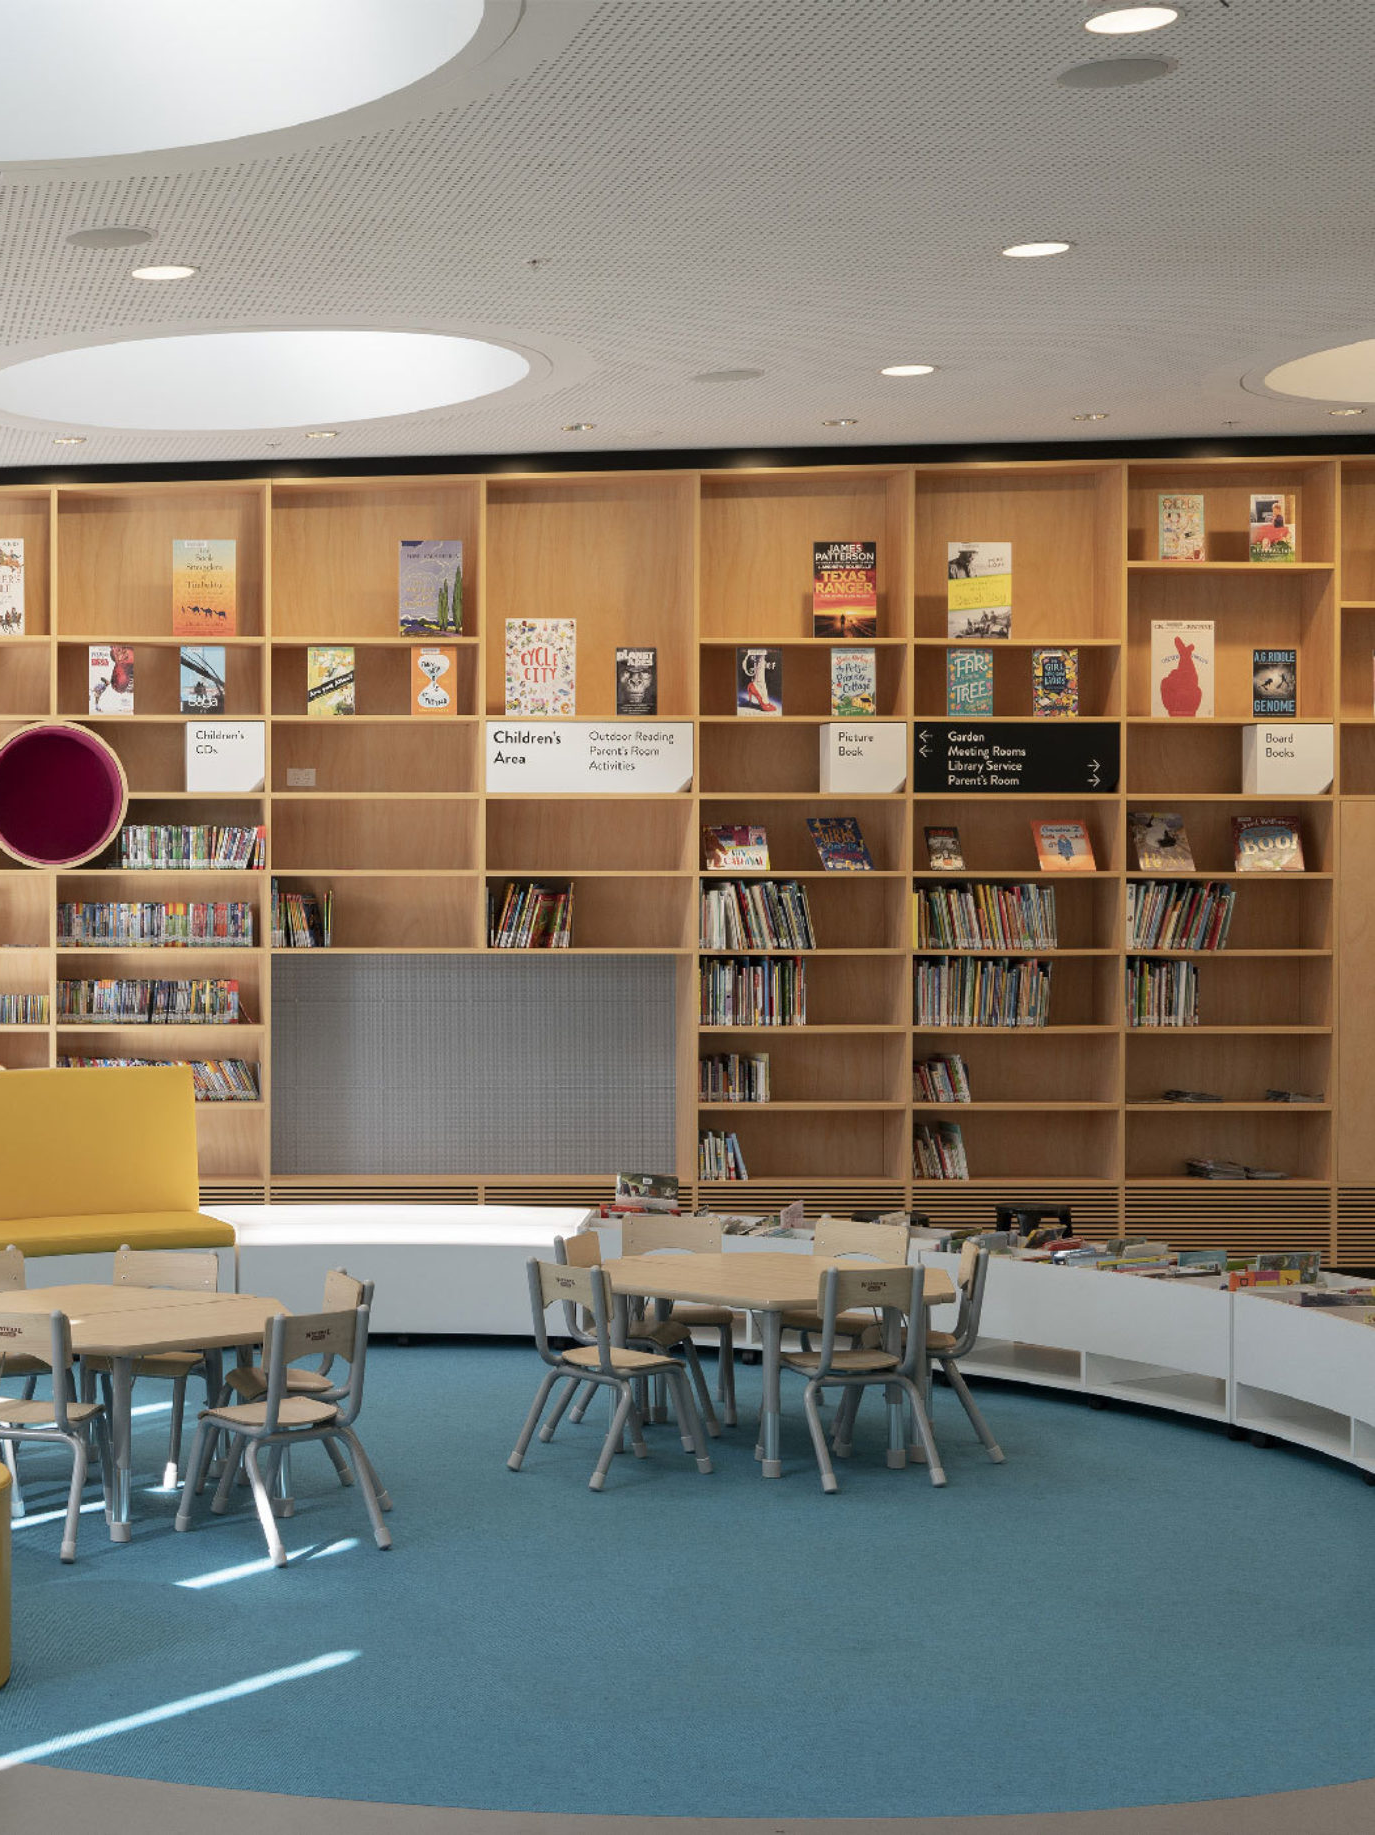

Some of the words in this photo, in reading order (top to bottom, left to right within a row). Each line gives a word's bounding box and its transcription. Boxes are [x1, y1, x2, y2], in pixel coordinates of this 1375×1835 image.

[827, 544, 863, 555] JAMES
[815, 552, 874, 561] PATTERSON
[820, 570, 867, 583] TEXAS
[815, 582, 874, 594] RANGER
[520, 646, 558, 667] CYCLE
[1268, 651, 1296, 662] RIDDLE
[954, 654, 988, 678] FAR
[1045, 663, 1064, 672] GIRL
[524, 667, 558, 683] CITY
[952, 681, 987, 703] TREE
[1253, 700, 1296, 712] GENOME
[195, 730, 245, 740] Children's
[493, 730, 562, 744] Children's
[588, 730, 632, 741] Outdoor
[635, 730, 675, 745] Reading
[837, 731, 874, 742] Picture
[947, 731, 985, 742] Garden
[1265, 733, 1294, 744] Board
[195, 744, 219, 754] CDs
[589, 745, 629, 757] Parent's
[630, 746, 660, 757] Room
[837, 746, 864, 757] Book
[947, 746, 990, 760] Meeting
[992, 746, 1026, 757] Rooms
[1265, 747, 1295, 758] Books
[493, 750, 526, 765] Area
[588, 760, 636, 771] Activities
[947, 760, 984, 774] Library
[985, 760, 1023, 771] Service
[947, 775, 988, 786] Parent's
[990, 775, 1020, 786] Room
[1241, 833, 1299, 855] BOO!
